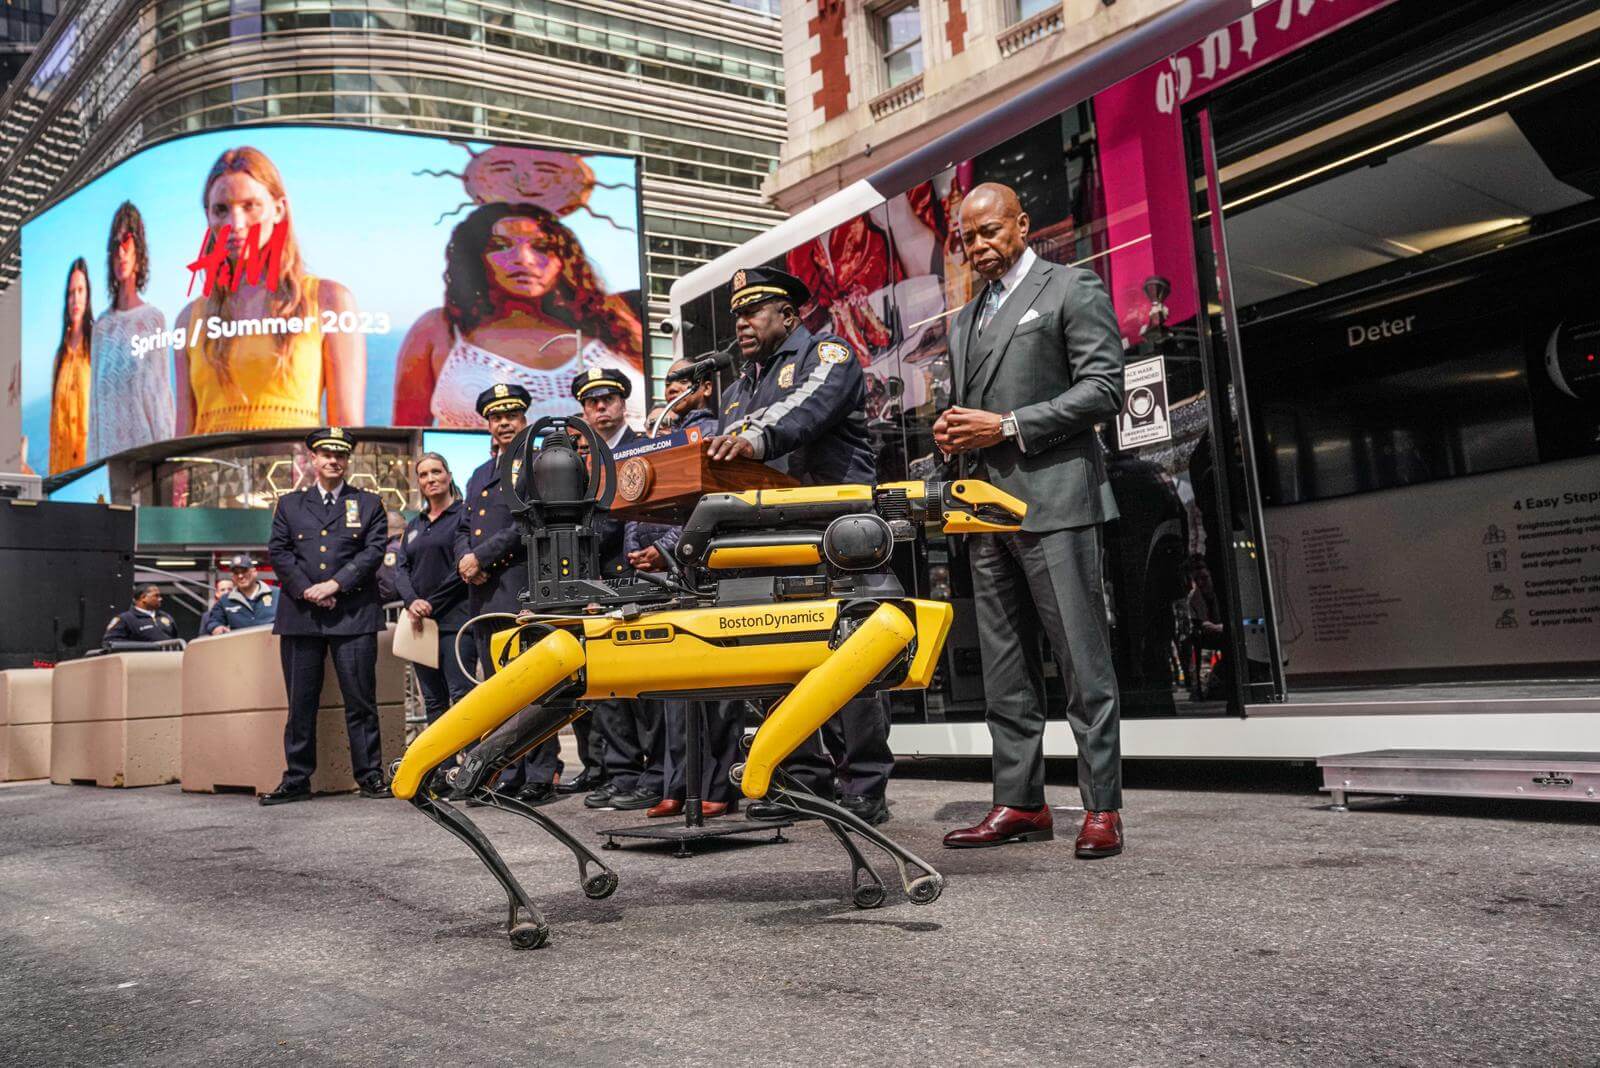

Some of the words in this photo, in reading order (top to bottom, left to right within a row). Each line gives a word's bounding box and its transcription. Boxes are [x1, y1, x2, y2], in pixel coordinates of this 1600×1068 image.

[186, 219, 289, 297] H&M
[130, 327, 186, 359] Spring
[189, 318, 203, 347] /
[207, 315, 317, 339] Summer
[320, 310, 391, 334] 2023
[1347, 315, 1416, 347] Deter
[1513, 500, 1522, 511] 4
[1526, 496, 1559, 509] Easy
[1563, 491, 1600, 505] Step
[1516, 518, 1571, 531] Knightscope
[1518, 527, 1583, 540] recommending
[1520, 549, 1560, 559] Generate
[1562, 545, 1587, 554] Order
[1522, 559, 1538, 568] and
[1540, 557, 1582, 568] signature
[1524, 577, 1578, 588] Countersign
[1525, 588, 1570, 597] technician
[1572, 586, 1585, 594] for
[1541, 619, 1560, 627] your
[1562, 615, 1592, 624] robots
